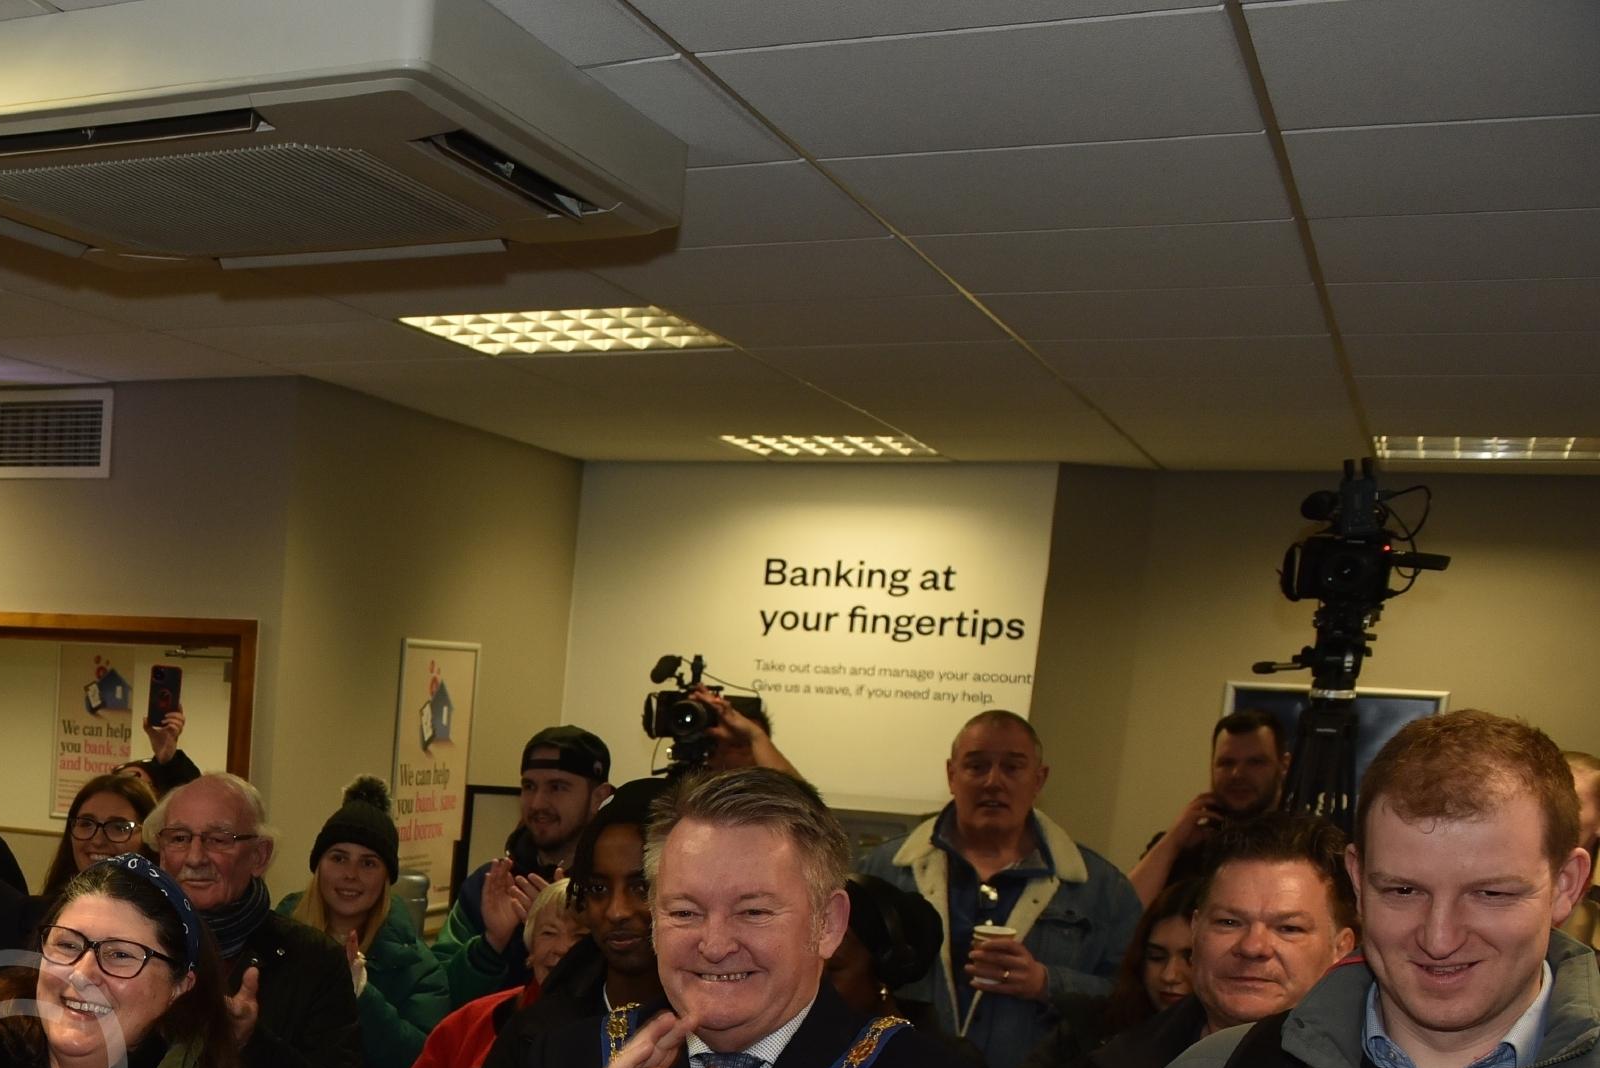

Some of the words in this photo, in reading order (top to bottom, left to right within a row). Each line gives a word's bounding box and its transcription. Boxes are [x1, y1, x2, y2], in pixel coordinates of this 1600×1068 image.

[764, 558, 911, 597] Banking
[920, 565, 957, 591] at
[760, 609, 838, 636] your
[849, 605, 1025, 646] fingertips
[755, 659, 786, 673] Take
[788, 661, 811, 674] out
[814, 661, 847, 676] cash
[849, 664, 876, 678] and
[878, 667, 935, 682] manage
[938, 671, 969, 684] your
[752, 679, 782, 693] Give
[785, 684, 800, 694] us
[803, 685, 811, 694] a
[855, 684, 865, 697] if
[867, 687, 893, 701] you
[895, 686, 931, 701] need
[933, 691, 960, 705] any
[62, 719, 80, 736] We
[83, 725, 103, 737] can
[106, 722, 132, 743] help
[60, 741, 81, 756] you
